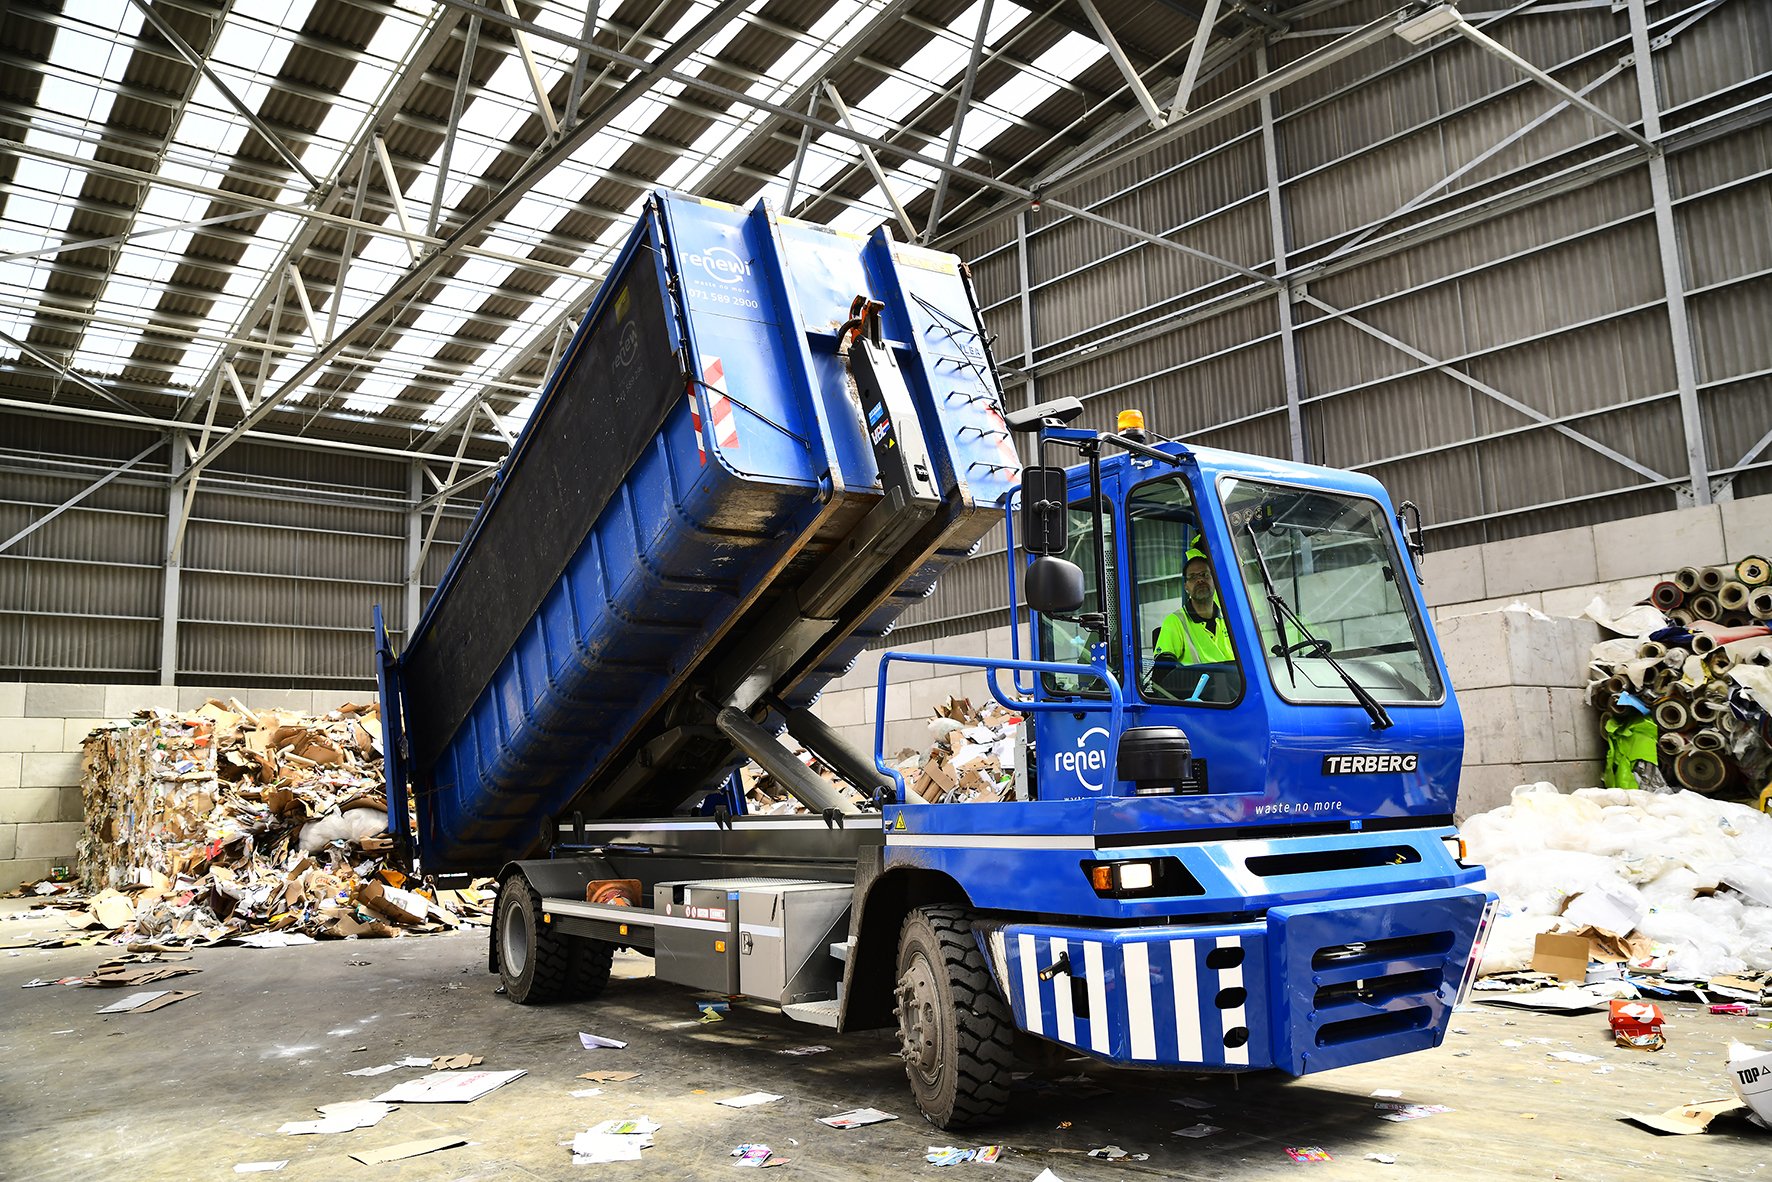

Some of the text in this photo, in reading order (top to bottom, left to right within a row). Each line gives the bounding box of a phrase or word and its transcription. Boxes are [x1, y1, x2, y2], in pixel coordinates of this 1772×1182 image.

[680, 250, 751, 281] renewi
[688, 288, 758, 309] 071 589 2900
[1327, 755, 1417, 774] TERBERG
[1255, 800, 1342, 815] waste no more
[1736, 1067, 1760, 1085] TOP
